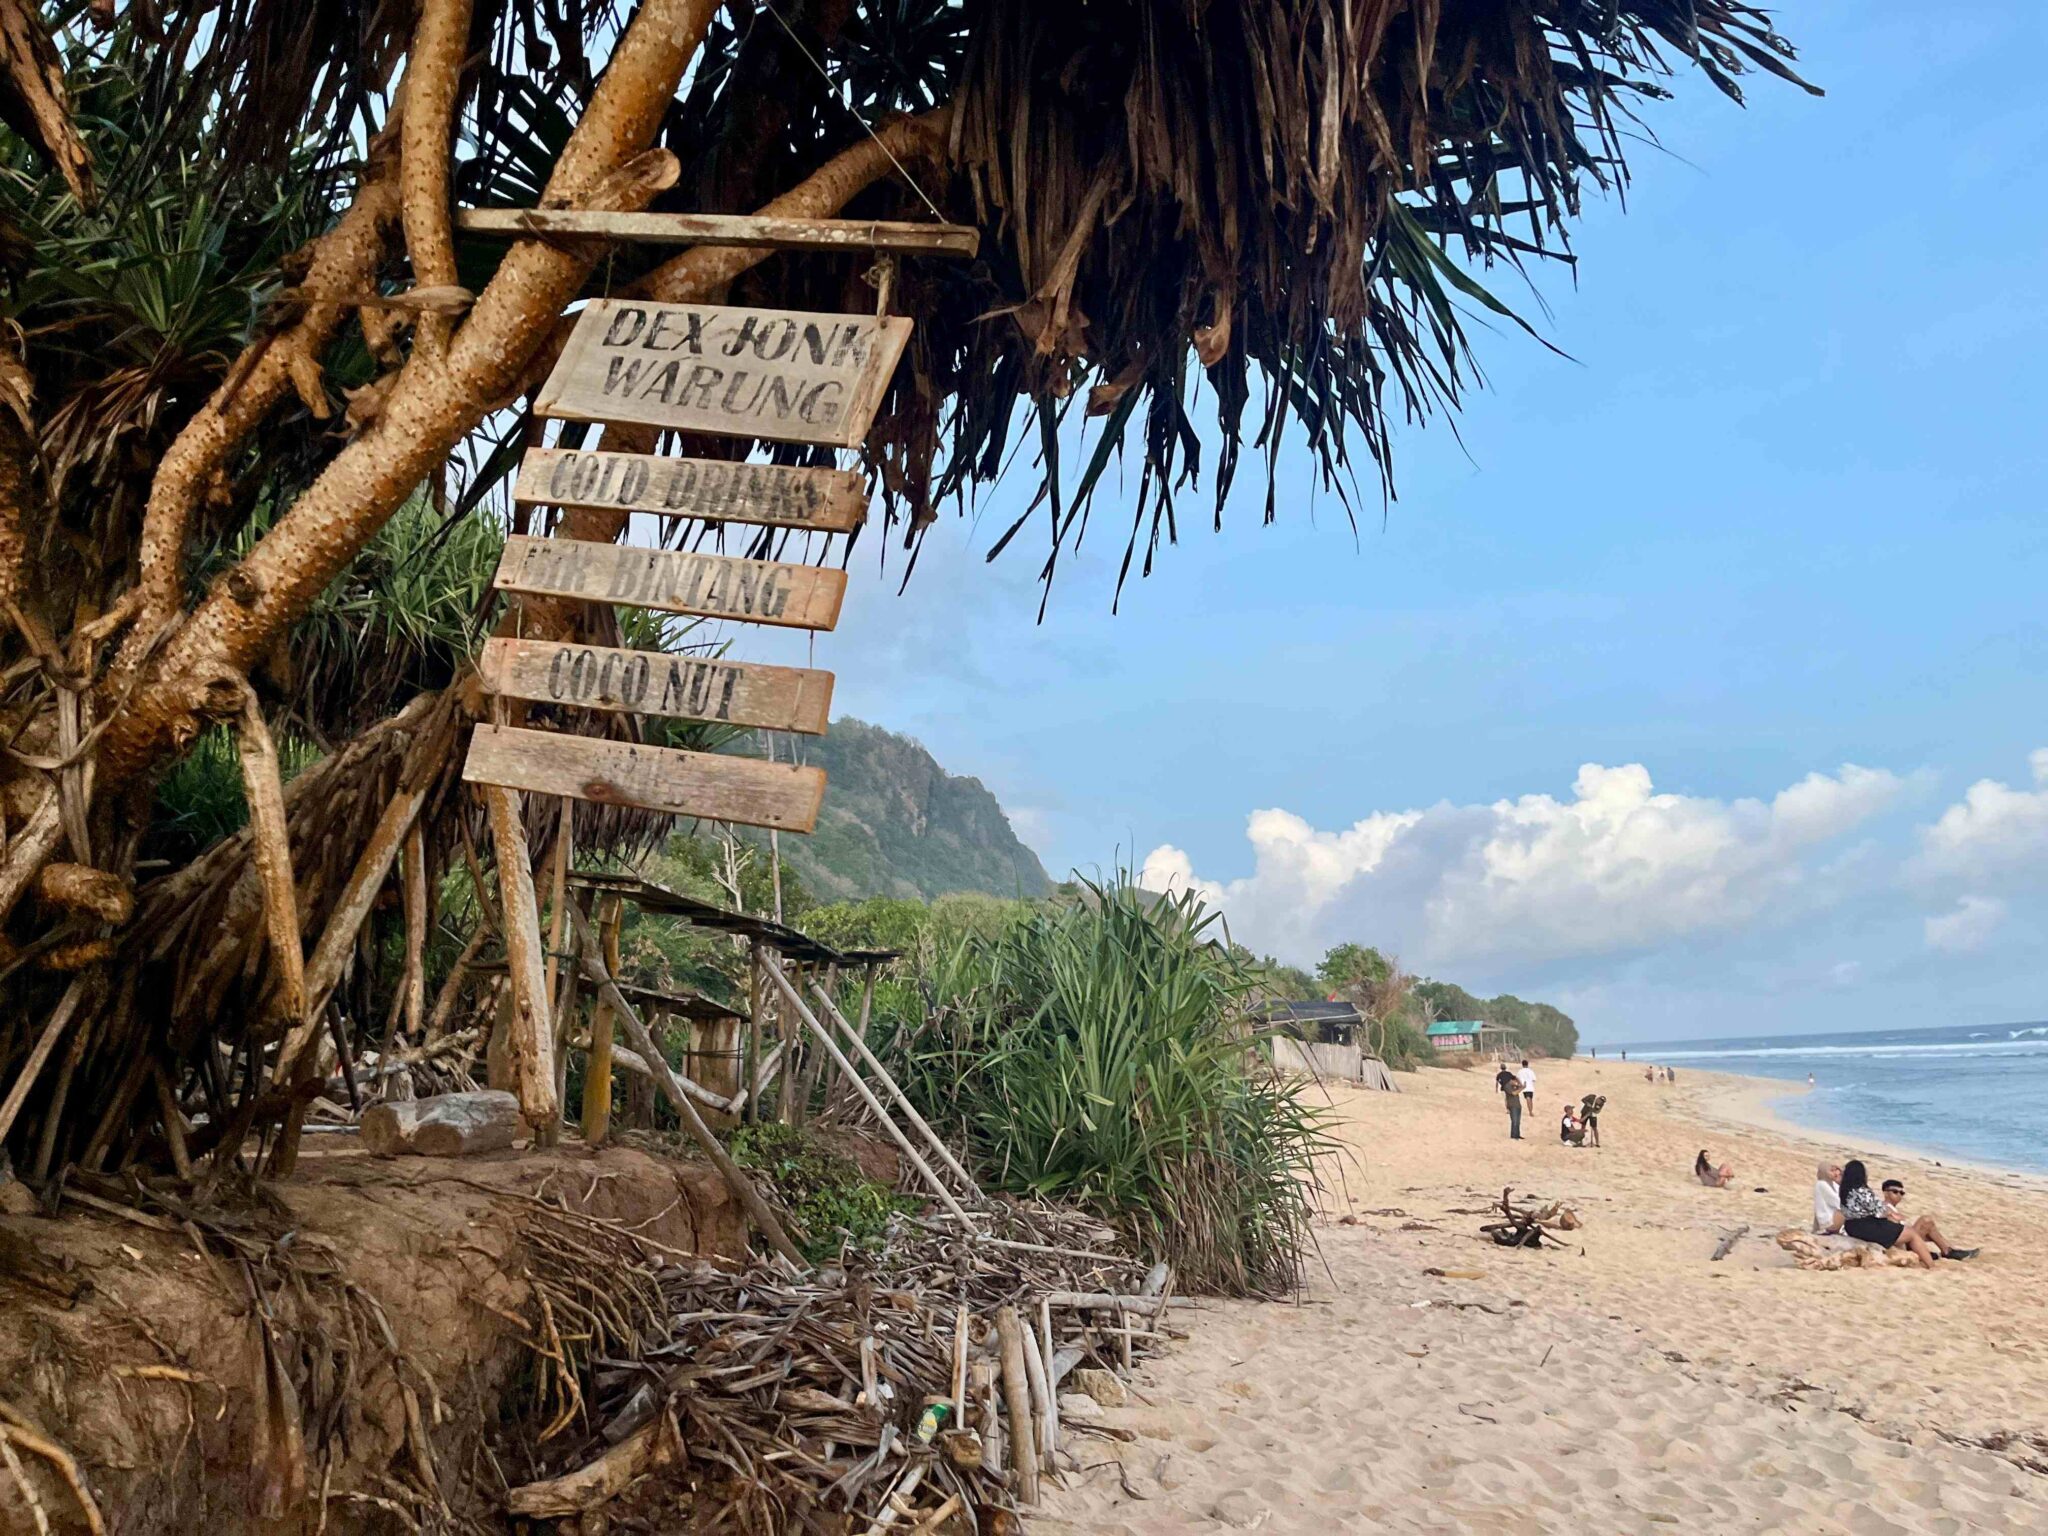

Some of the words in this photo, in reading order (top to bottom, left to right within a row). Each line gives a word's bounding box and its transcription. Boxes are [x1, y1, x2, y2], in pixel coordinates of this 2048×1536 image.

[602, 308, 718, 354] DEX
[602, 355, 843, 425] WARUNG
[550, 453, 650, 505] COLD
[606, 549, 793, 618] BINTANG
[549, 647, 650, 706] COCO
[659, 660, 744, 720] NUT
